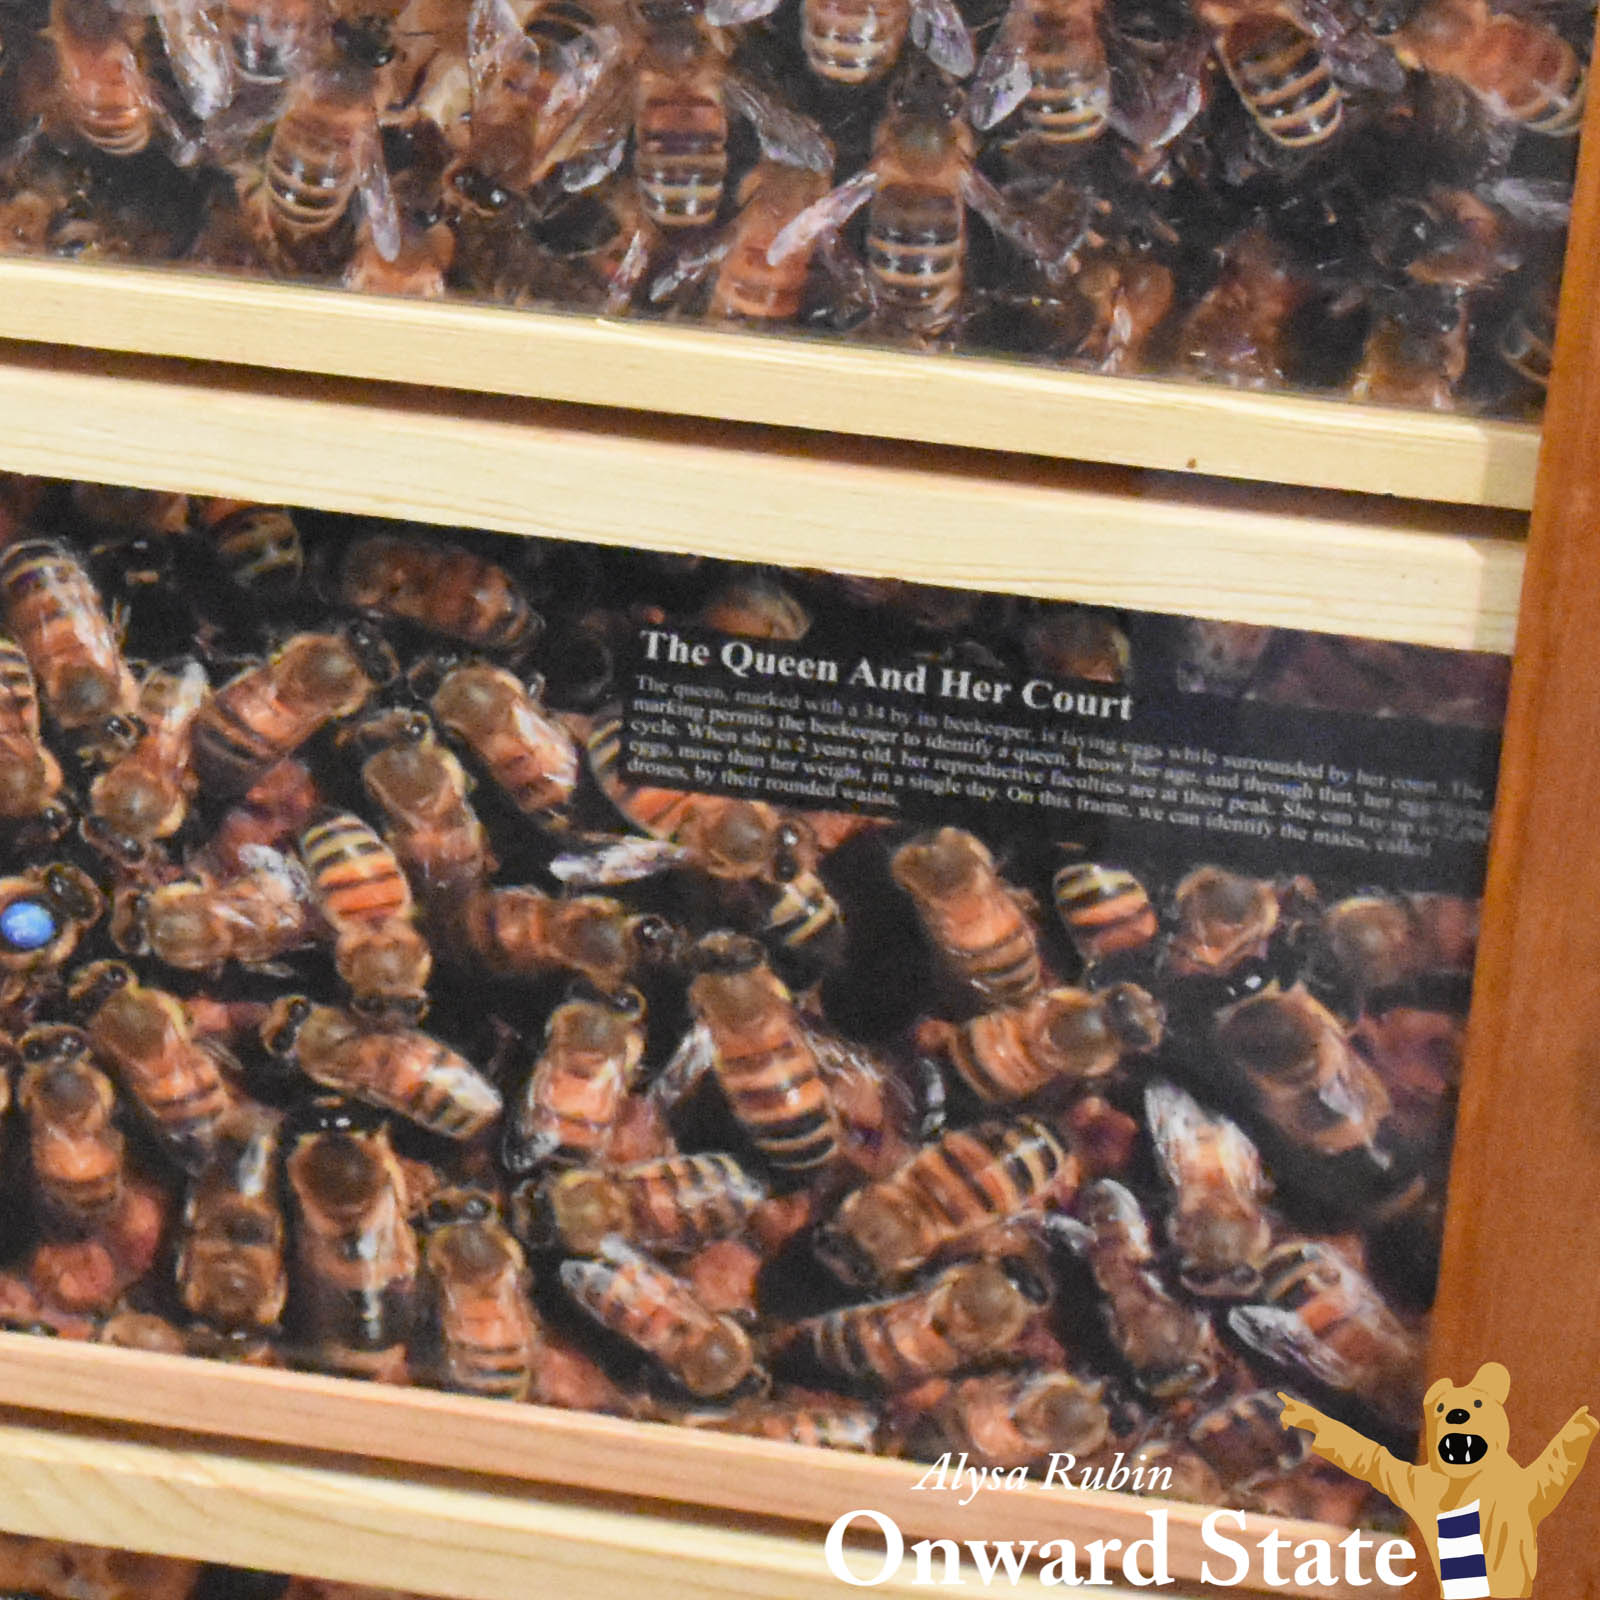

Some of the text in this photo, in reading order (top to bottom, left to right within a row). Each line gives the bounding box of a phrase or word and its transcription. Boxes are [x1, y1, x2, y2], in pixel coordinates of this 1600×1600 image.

[639, 630, 1135, 721] The Queen And Her Court
[633, 699, 1391, 808] marking permits the beekeeper to identify a know and through her
[635, 674, 1386, 786] The with a by by her
[686, 723, 1353, 826] When she is years her reproductive faculties are at their She can
[677, 747, 1308, 841] more than her in a single On this we can identify the
[694, 763, 836, 797] by their rounded
